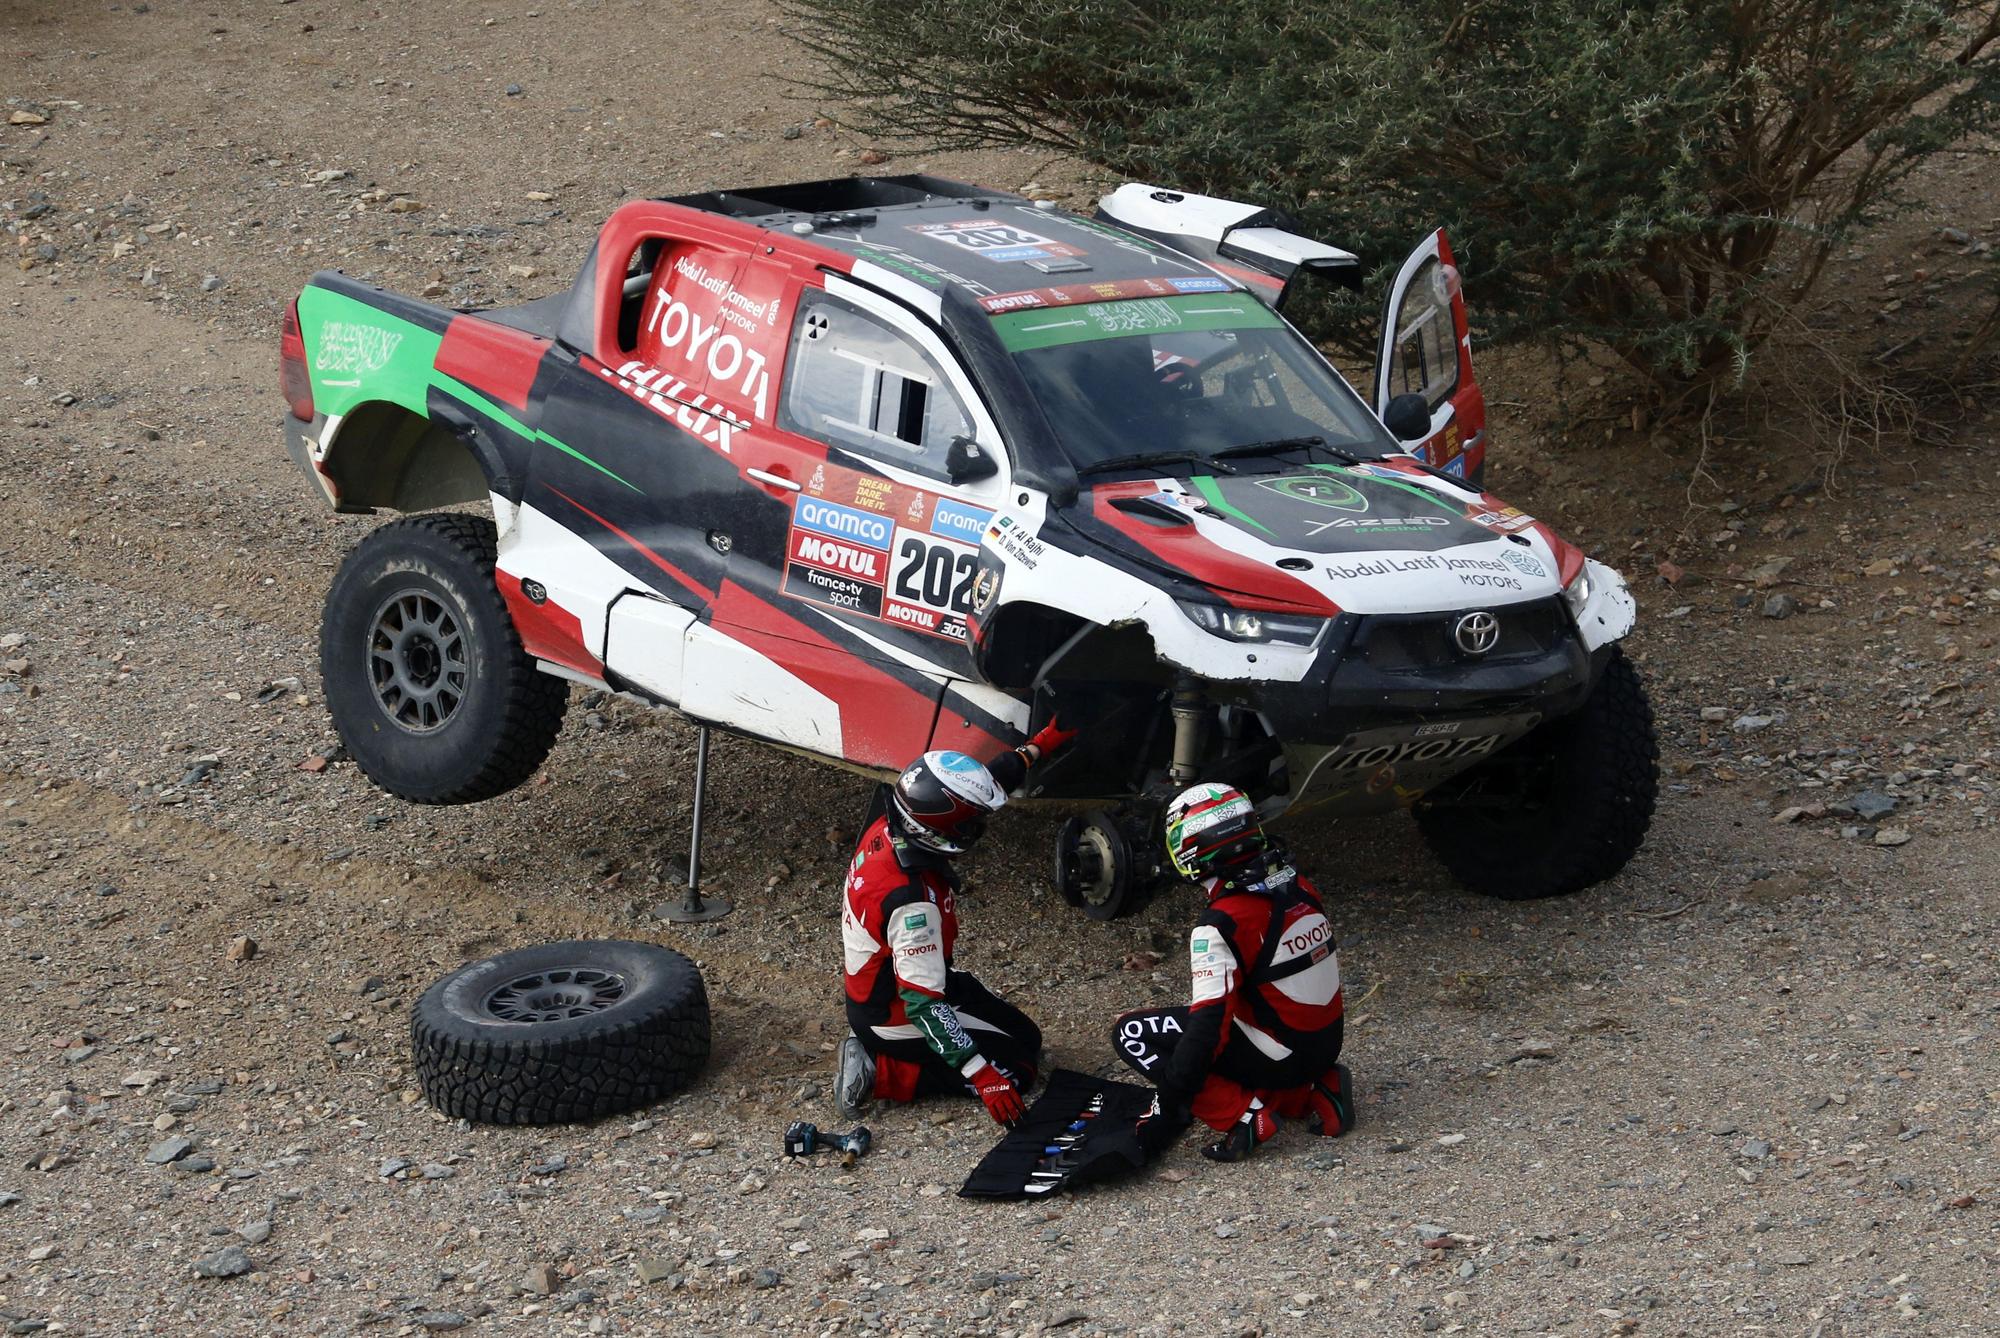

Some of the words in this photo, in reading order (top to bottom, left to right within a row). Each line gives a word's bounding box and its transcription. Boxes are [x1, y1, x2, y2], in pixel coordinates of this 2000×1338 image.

[673, 255, 701, 281] Abdul
[698, 268, 728, 297] Latif
[721, 283, 767, 319] Jameel
[987, 294, 1041, 312] MOTUL
[717, 305, 758, 334] MOTORS
[647, 287, 769, 420] TOYOTA
[600, 360, 752, 454] HILUX
[855, 486, 883, 501] DARE.
[858, 477, 893, 494] DREAM.
[854, 496, 875, 509] LIVE
[802, 503, 886, 541] aramco
[1354, 525, 1433, 534] RACING
[797, 536, 876, 577] MOTUL
[1004, 539, 1016, 555] Von
[1015, 530, 1028, 542] Al
[1023, 536, 1046, 557] Rajhi
[896, 538, 979, 614] 202
[1325, 558, 1391, 581] Abdul
[1393, 555, 1438, 572] Latif
[1442, 555, 1511, 573] Jameel
[1459, 574, 1523, 591] MOTORS
[829, 591, 861, 609] sport
[887, 603, 935, 627] MOTUL
[1336, 735, 1499, 771] TOYOTA
[903, 943, 938, 957] TOYOTA
[1119, 1015, 1184, 1071] TOYOTA
